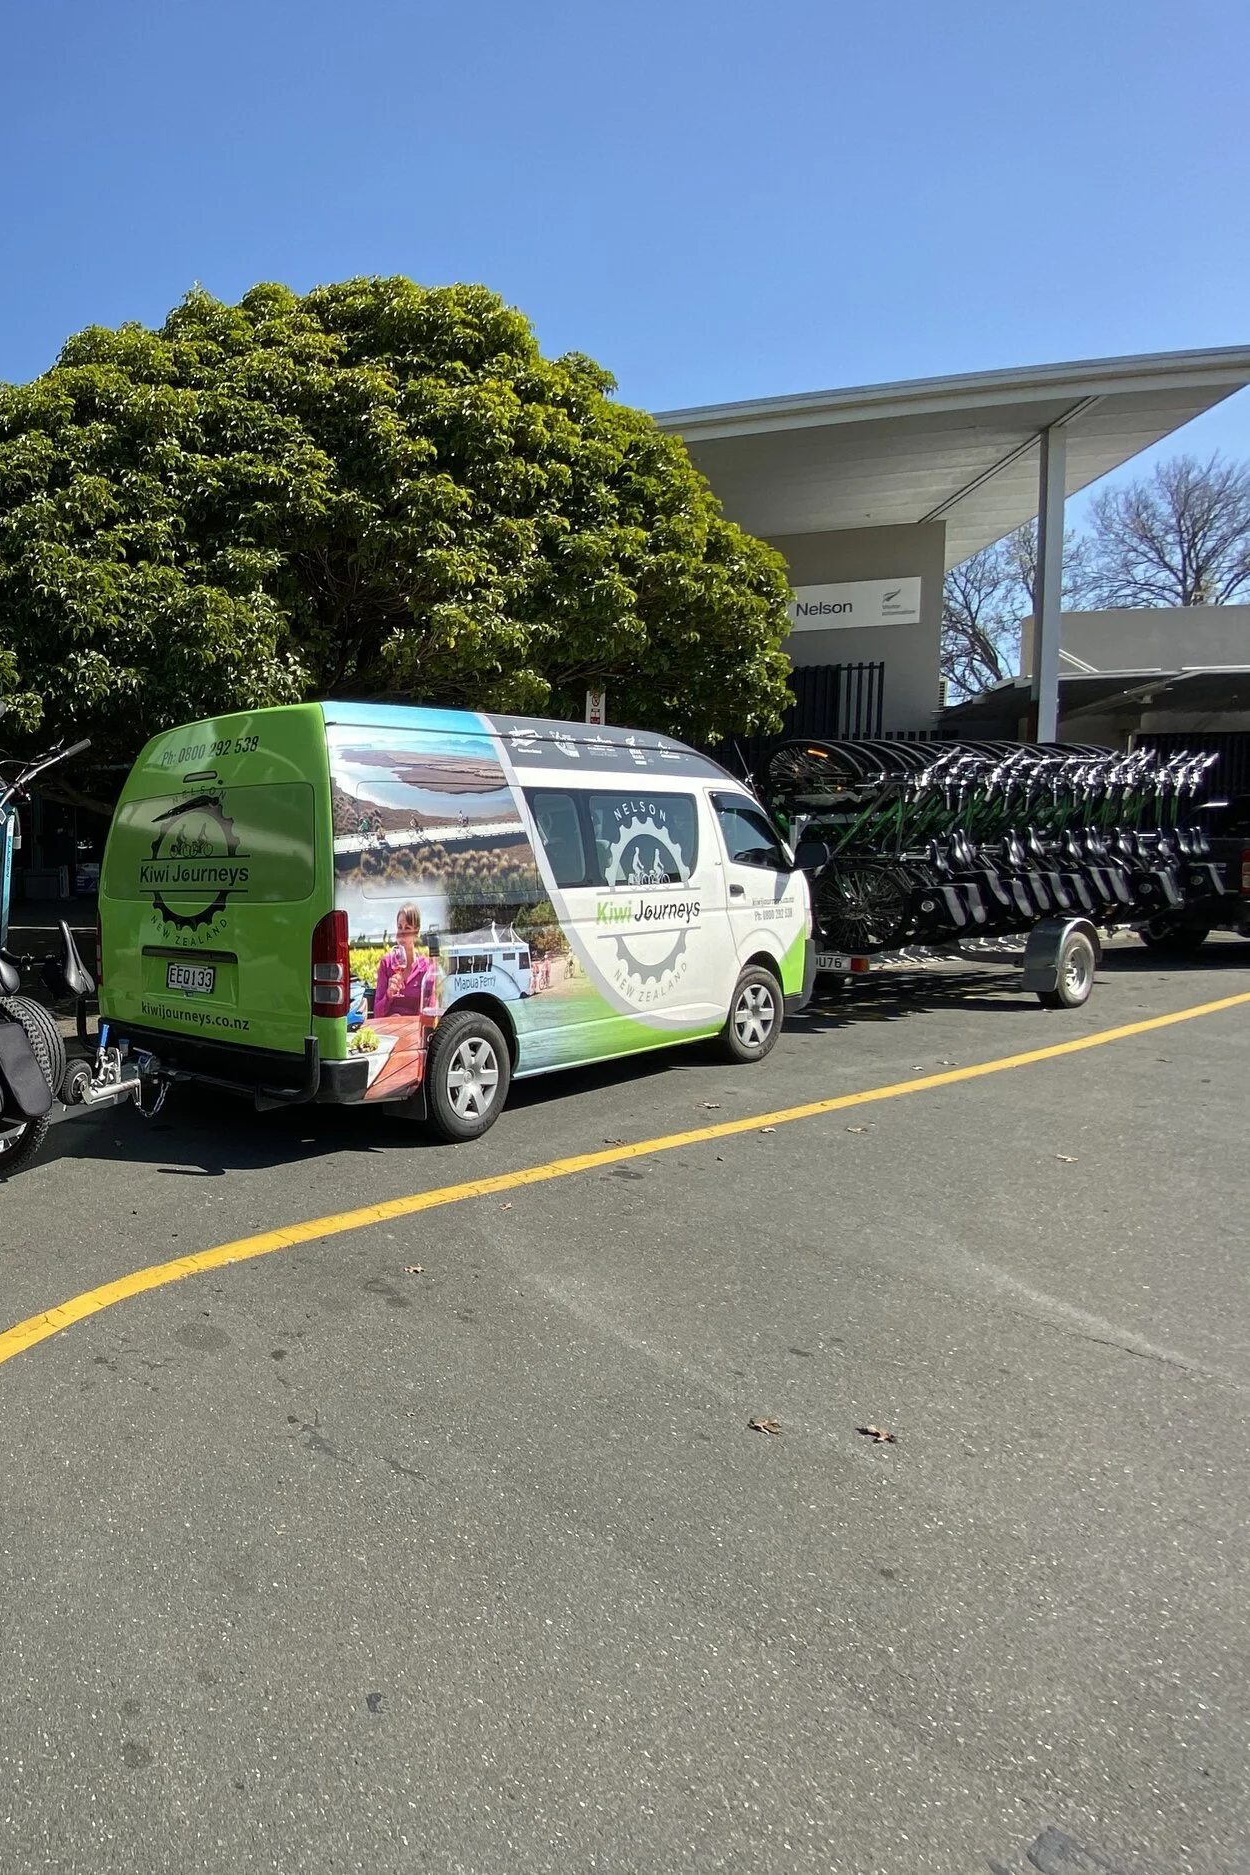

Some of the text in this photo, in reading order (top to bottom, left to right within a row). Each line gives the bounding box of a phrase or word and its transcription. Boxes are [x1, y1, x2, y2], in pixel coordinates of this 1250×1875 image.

[795, 602, 853, 616] Nelson
[178, 744, 206, 763] 0800
[208, 740, 231, 757] 292
[234, 735, 260, 754] 538
[613, 801, 667, 822] NELSON
[139, 864, 249, 887] Kiwi Journeys
[596, 900, 701, 924] Kiwi Journeys
[151, 915, 228, 946] NEW ZEALAND
[815, 956, 842, 968] U76
[454, 975, 496, 991] Mapua Ferry
[614, 962, 688, 1002] NEW ZEALAND
[141, 1001, 250, 1031] kiwijourneys.co.nz
